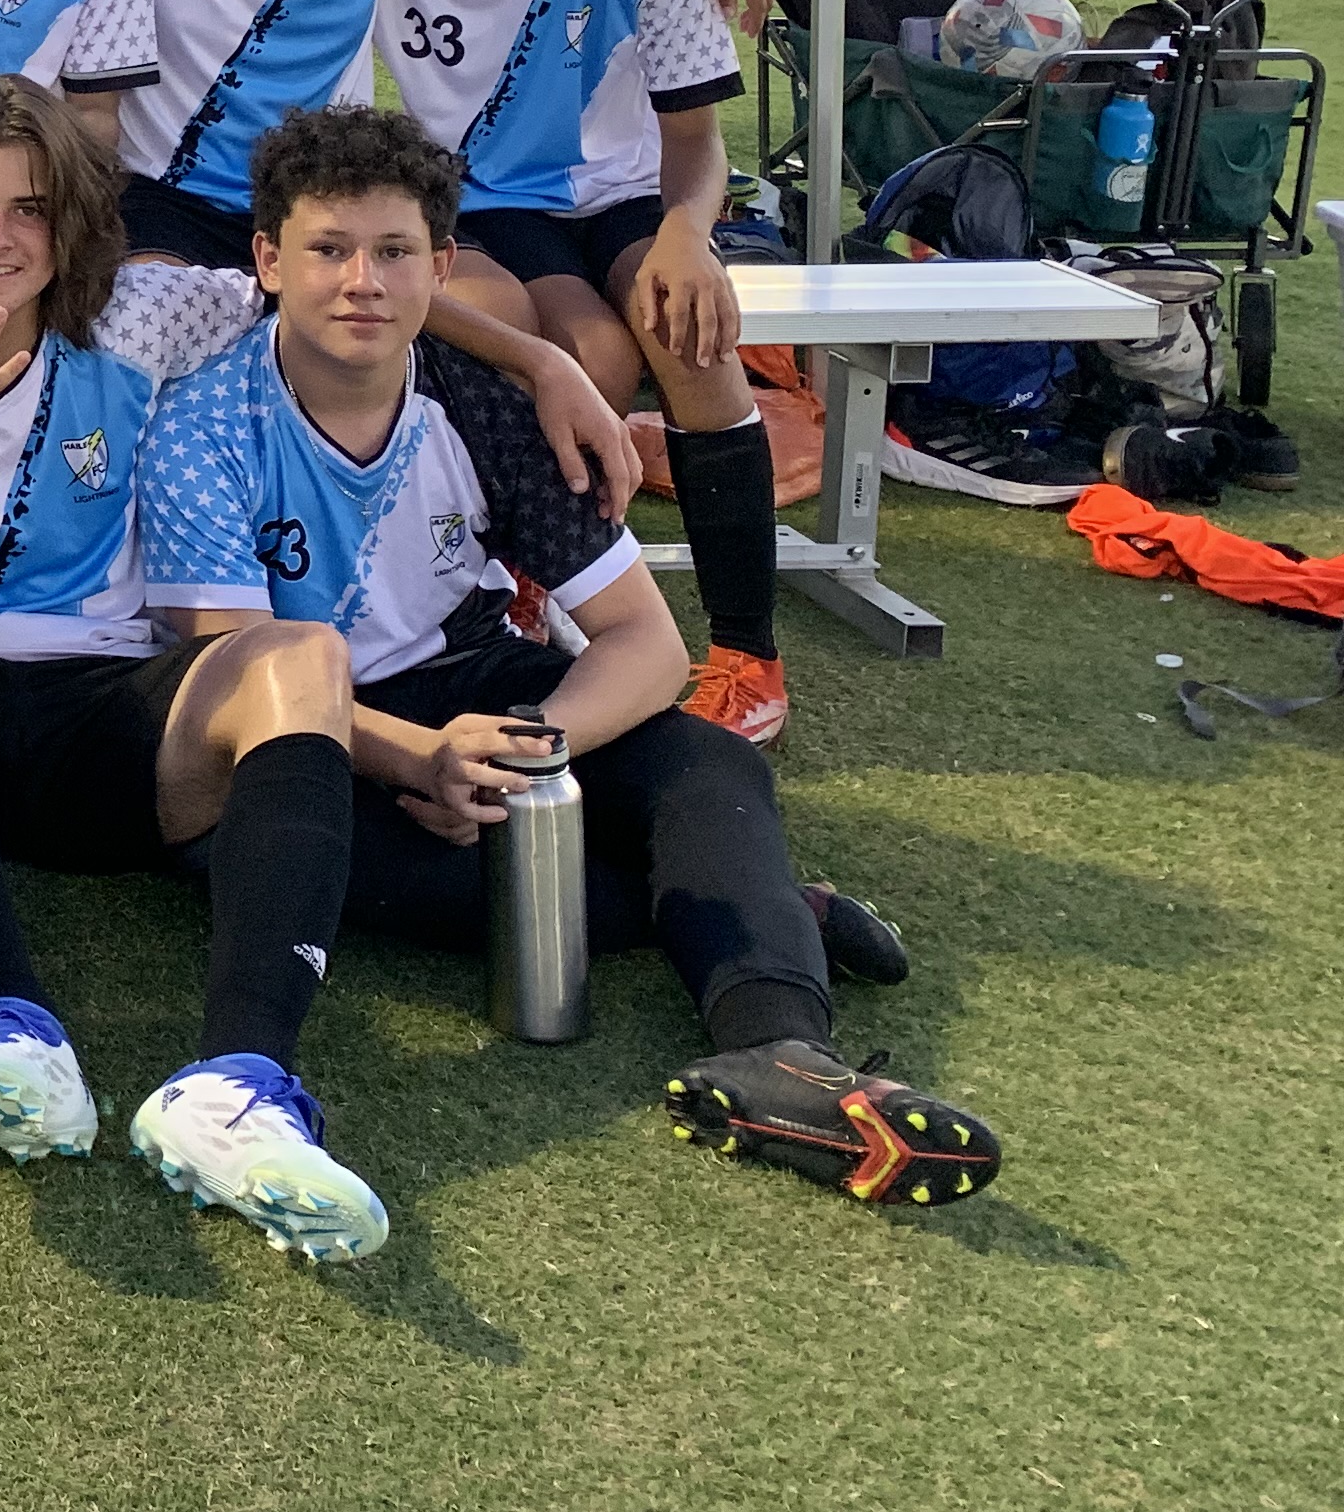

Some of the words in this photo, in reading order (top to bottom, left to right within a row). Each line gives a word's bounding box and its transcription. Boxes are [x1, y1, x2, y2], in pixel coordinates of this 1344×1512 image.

[401, 7, 465, 67] 33
[92, 463, 106, 476] FC
[254, 517, 311, 582] 23
[445, 538, 458, 548] FC
